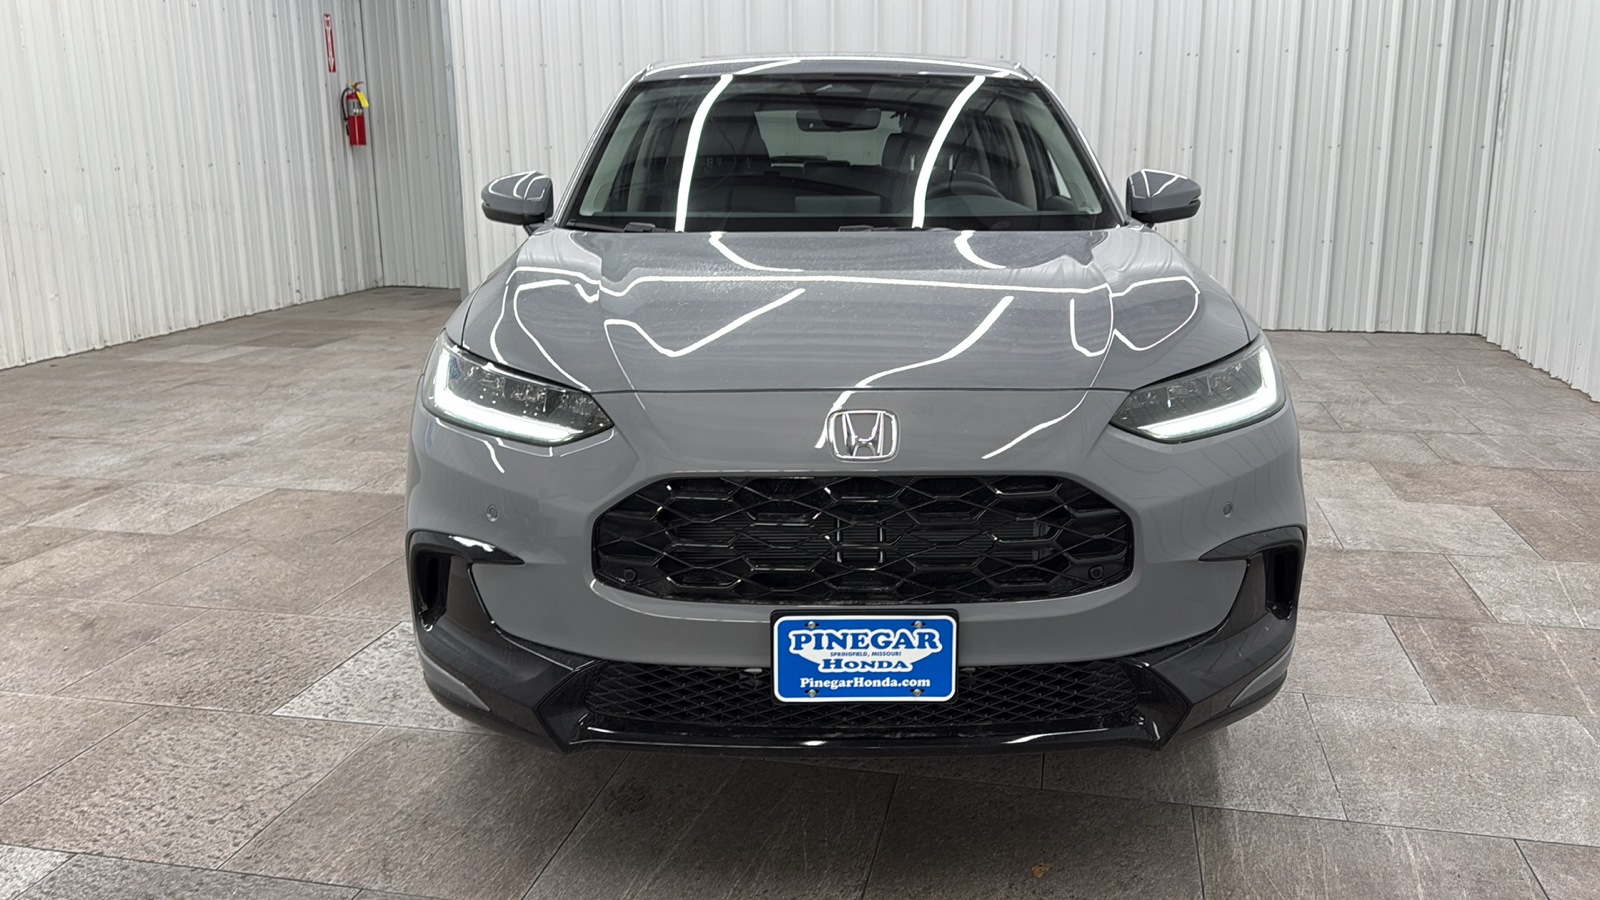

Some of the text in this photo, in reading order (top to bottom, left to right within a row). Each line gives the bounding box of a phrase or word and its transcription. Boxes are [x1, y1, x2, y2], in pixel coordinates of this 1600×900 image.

[792, 631, 940, 650] PINEGAR
[821, 658, 910, 669] HONDA
[800, 676, 931, 690] PinegarHonda.com
